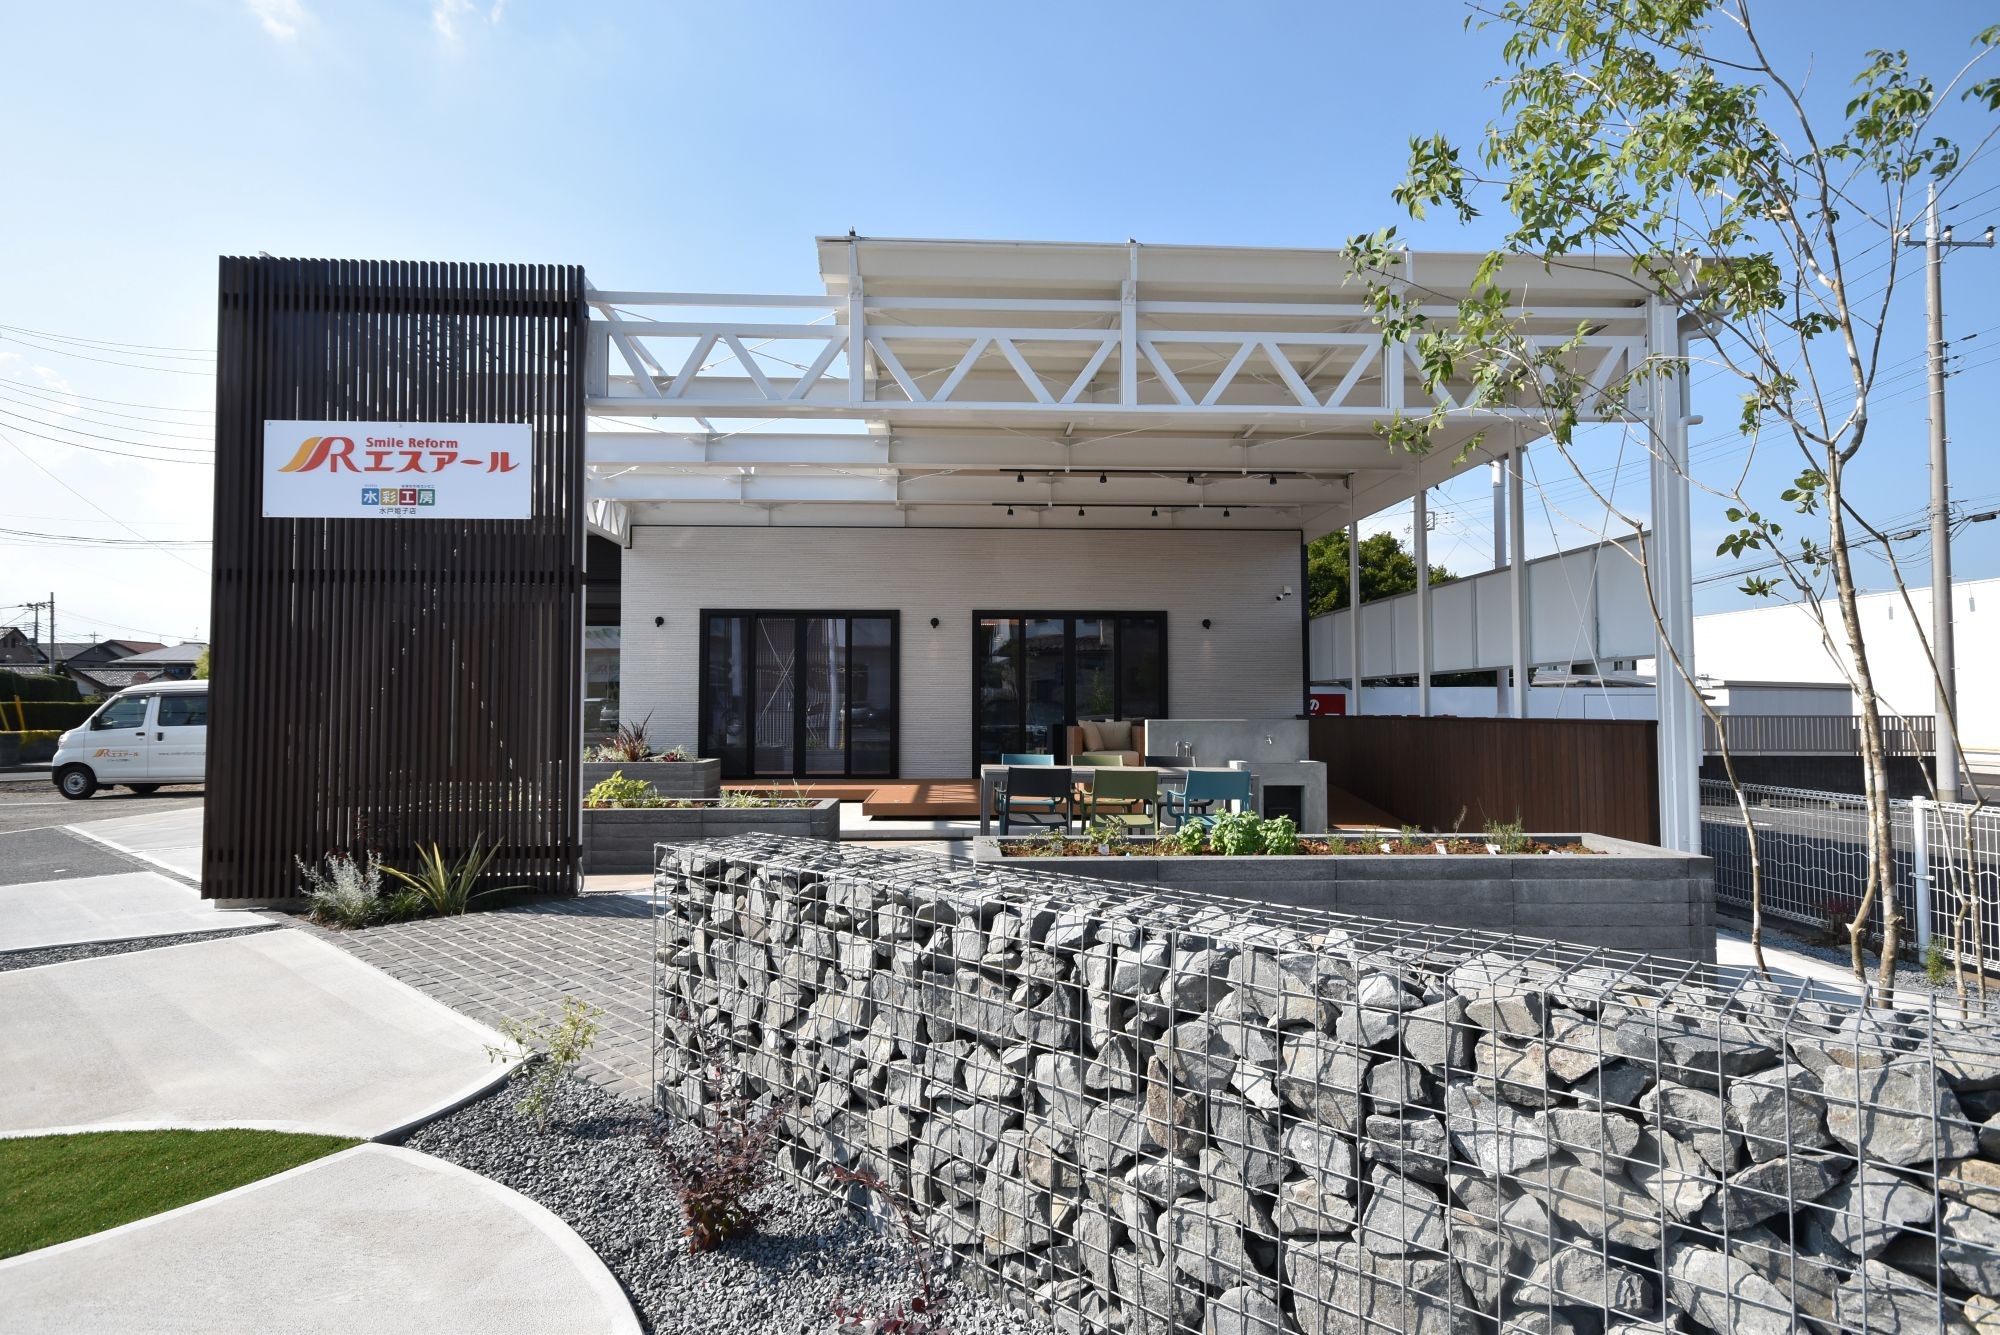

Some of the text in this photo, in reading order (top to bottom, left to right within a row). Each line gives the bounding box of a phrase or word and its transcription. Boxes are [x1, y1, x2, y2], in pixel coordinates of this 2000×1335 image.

[366, 437, 458, 449] Smile Reform
[364, 451, 521, 474] エスアール
[363, 490, 434, 504] 水彩工房
